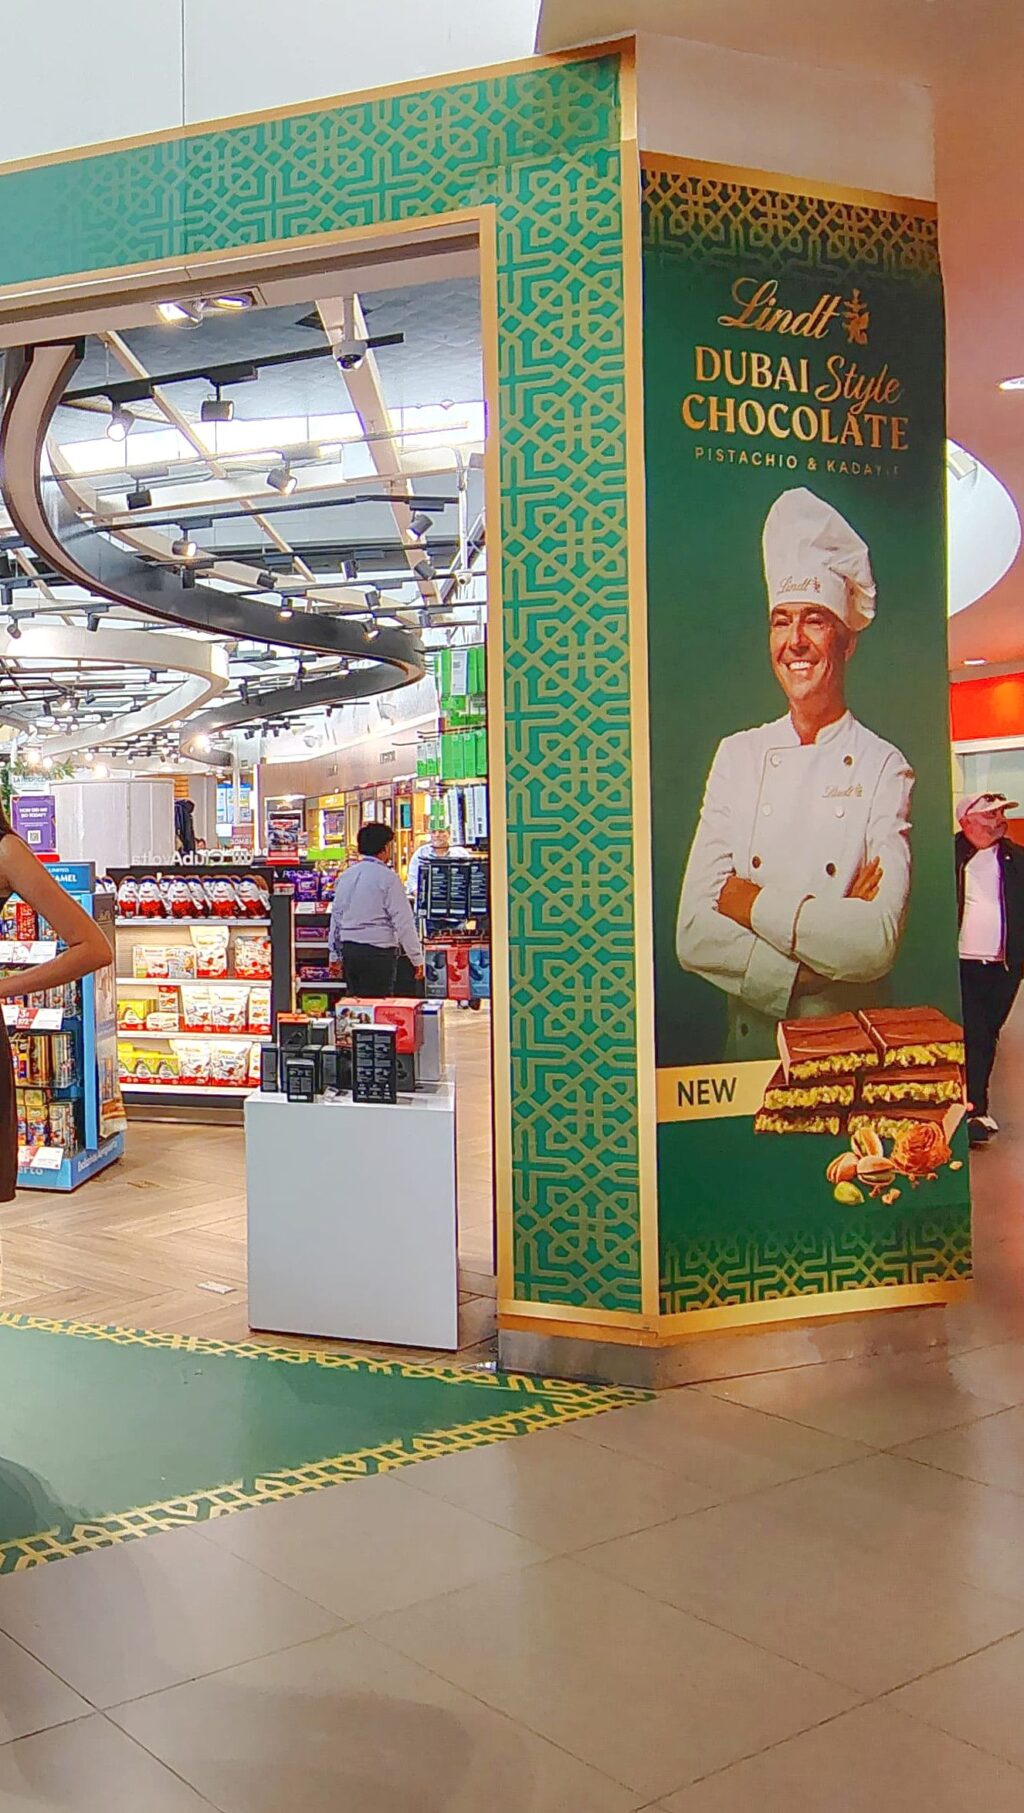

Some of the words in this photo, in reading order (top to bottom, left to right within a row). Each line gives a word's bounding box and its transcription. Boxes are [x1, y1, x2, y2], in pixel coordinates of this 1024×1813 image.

[717, 277, 842, 340] Lindt
[695, 345, 809, 393] DUBAI
[814, 354, 904, 415] Style
[682, 393, 909, 451] CHOCOLATE
[695, 447, 798, 470] PISTACHIO
[807, 457, 817, 471] &
[55, 874, 78, 882] AMEL
[678, 1077, 737, 1107] NEW
